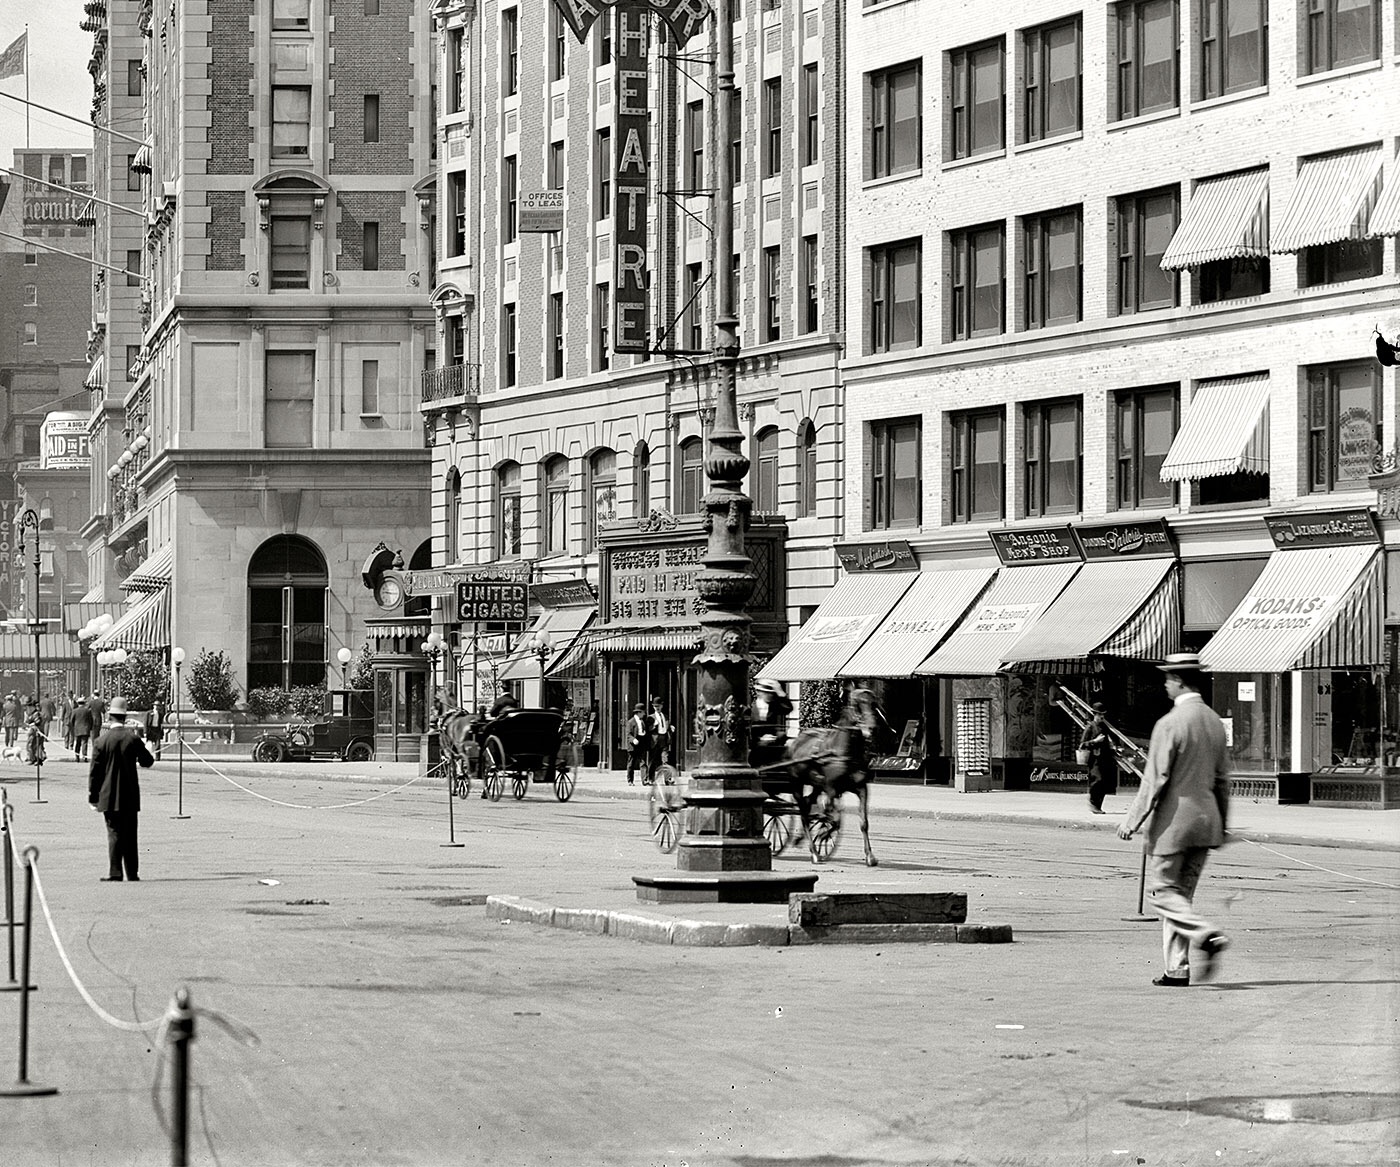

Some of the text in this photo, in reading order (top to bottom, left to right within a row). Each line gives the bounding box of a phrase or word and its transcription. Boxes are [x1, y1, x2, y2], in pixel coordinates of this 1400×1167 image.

[0, 501, 9, 582] VICTORIA
[1008, 531, 1059, 546] Ansonia
[1040, 545, 1069, 557] SHOP
[461, 586, 525, 601] UNITED
[460, 602, 526, 618] CIGARS
[1248, 597, 1321, 614] KODAKS
[883, 620, 949, 634] DONNELLY
[1232, 617, 1274, 630] OPTICAL
